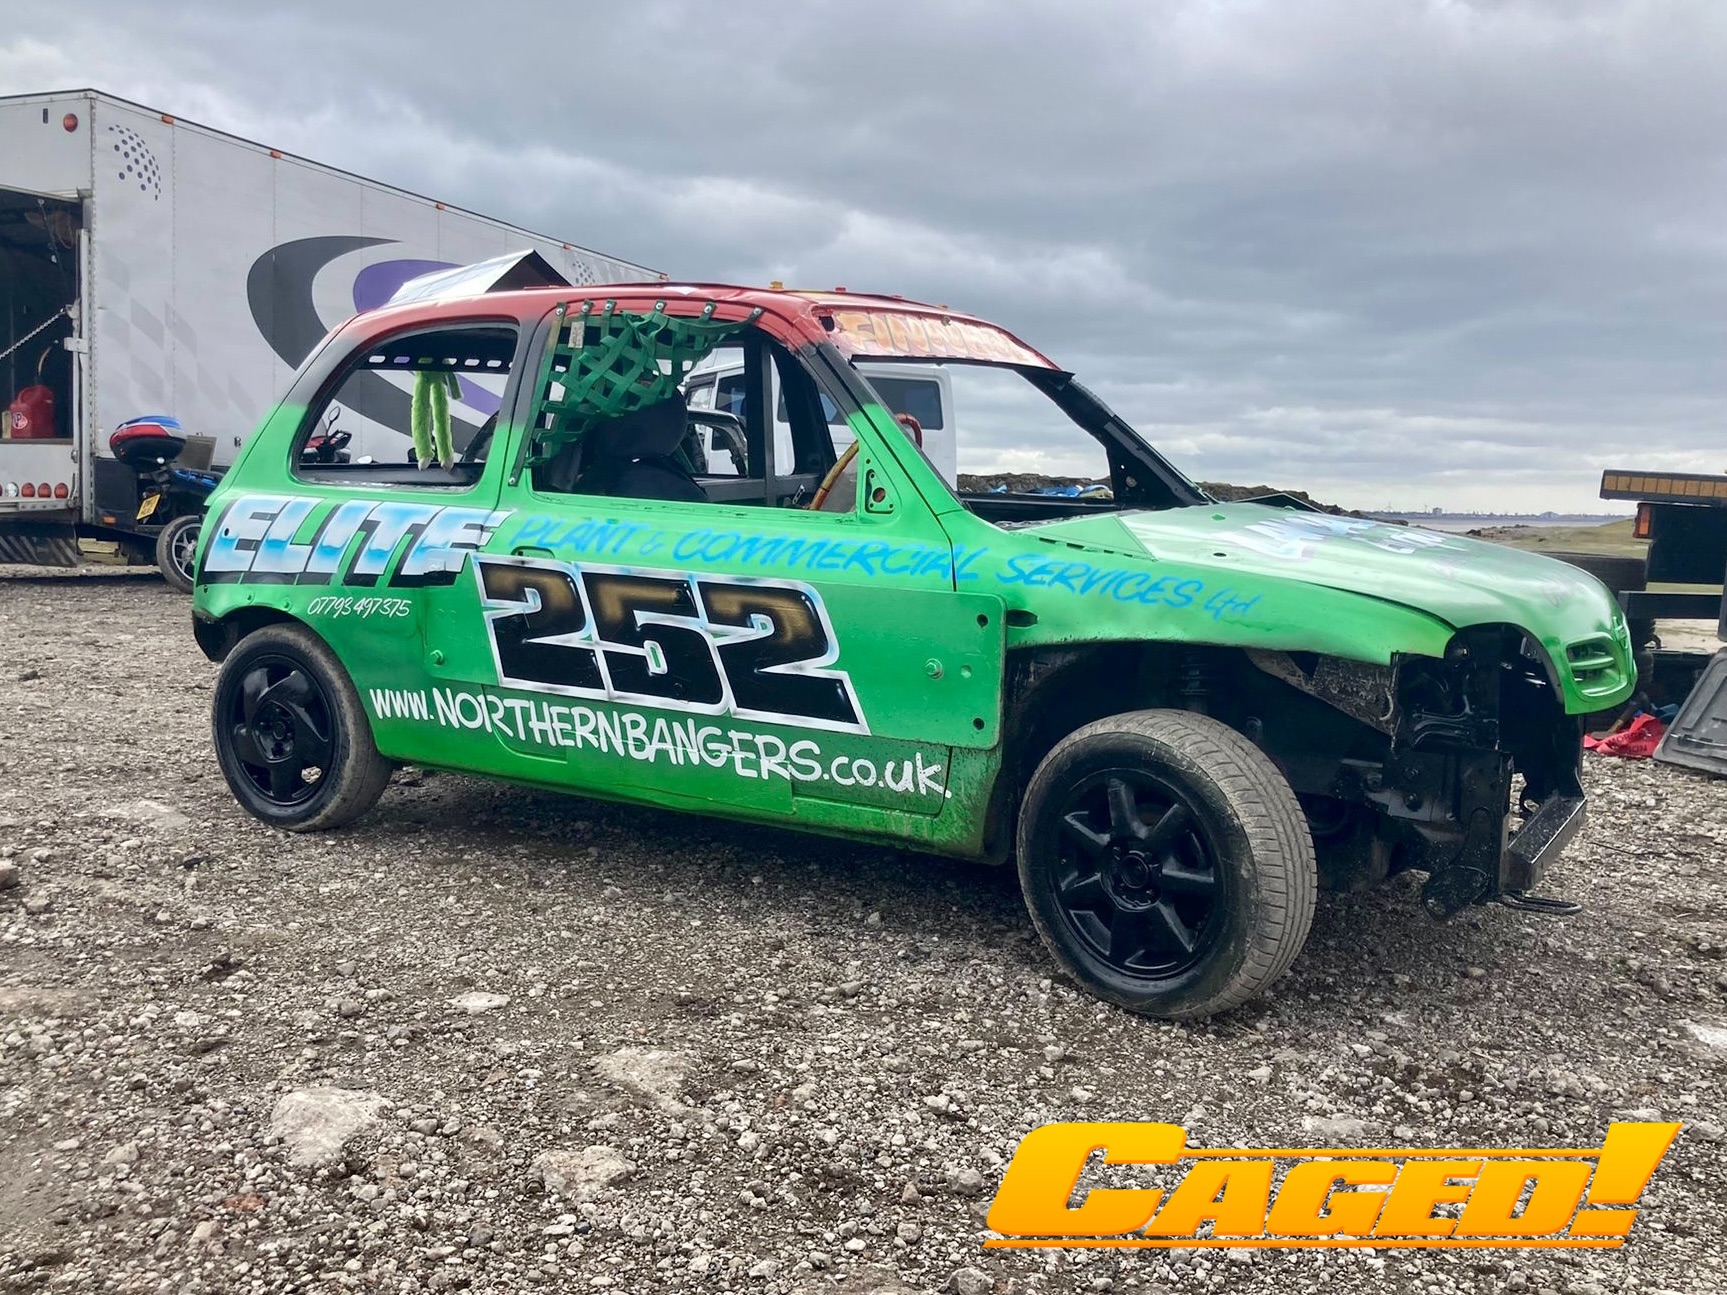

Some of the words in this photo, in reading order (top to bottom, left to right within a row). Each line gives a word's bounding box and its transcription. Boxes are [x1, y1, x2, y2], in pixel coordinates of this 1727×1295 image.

[198, 494, 515, 588] ELITE
[509, 516, 651, 554] PLANT
[673, 528, 988, 581] COMMERCIAL
[996, 553, 1203, 608] SERVICES
[307, 596, 353, 618] 07793
[353, 597, 412, 618] 497375
[473, 553, 871, 736] 252
